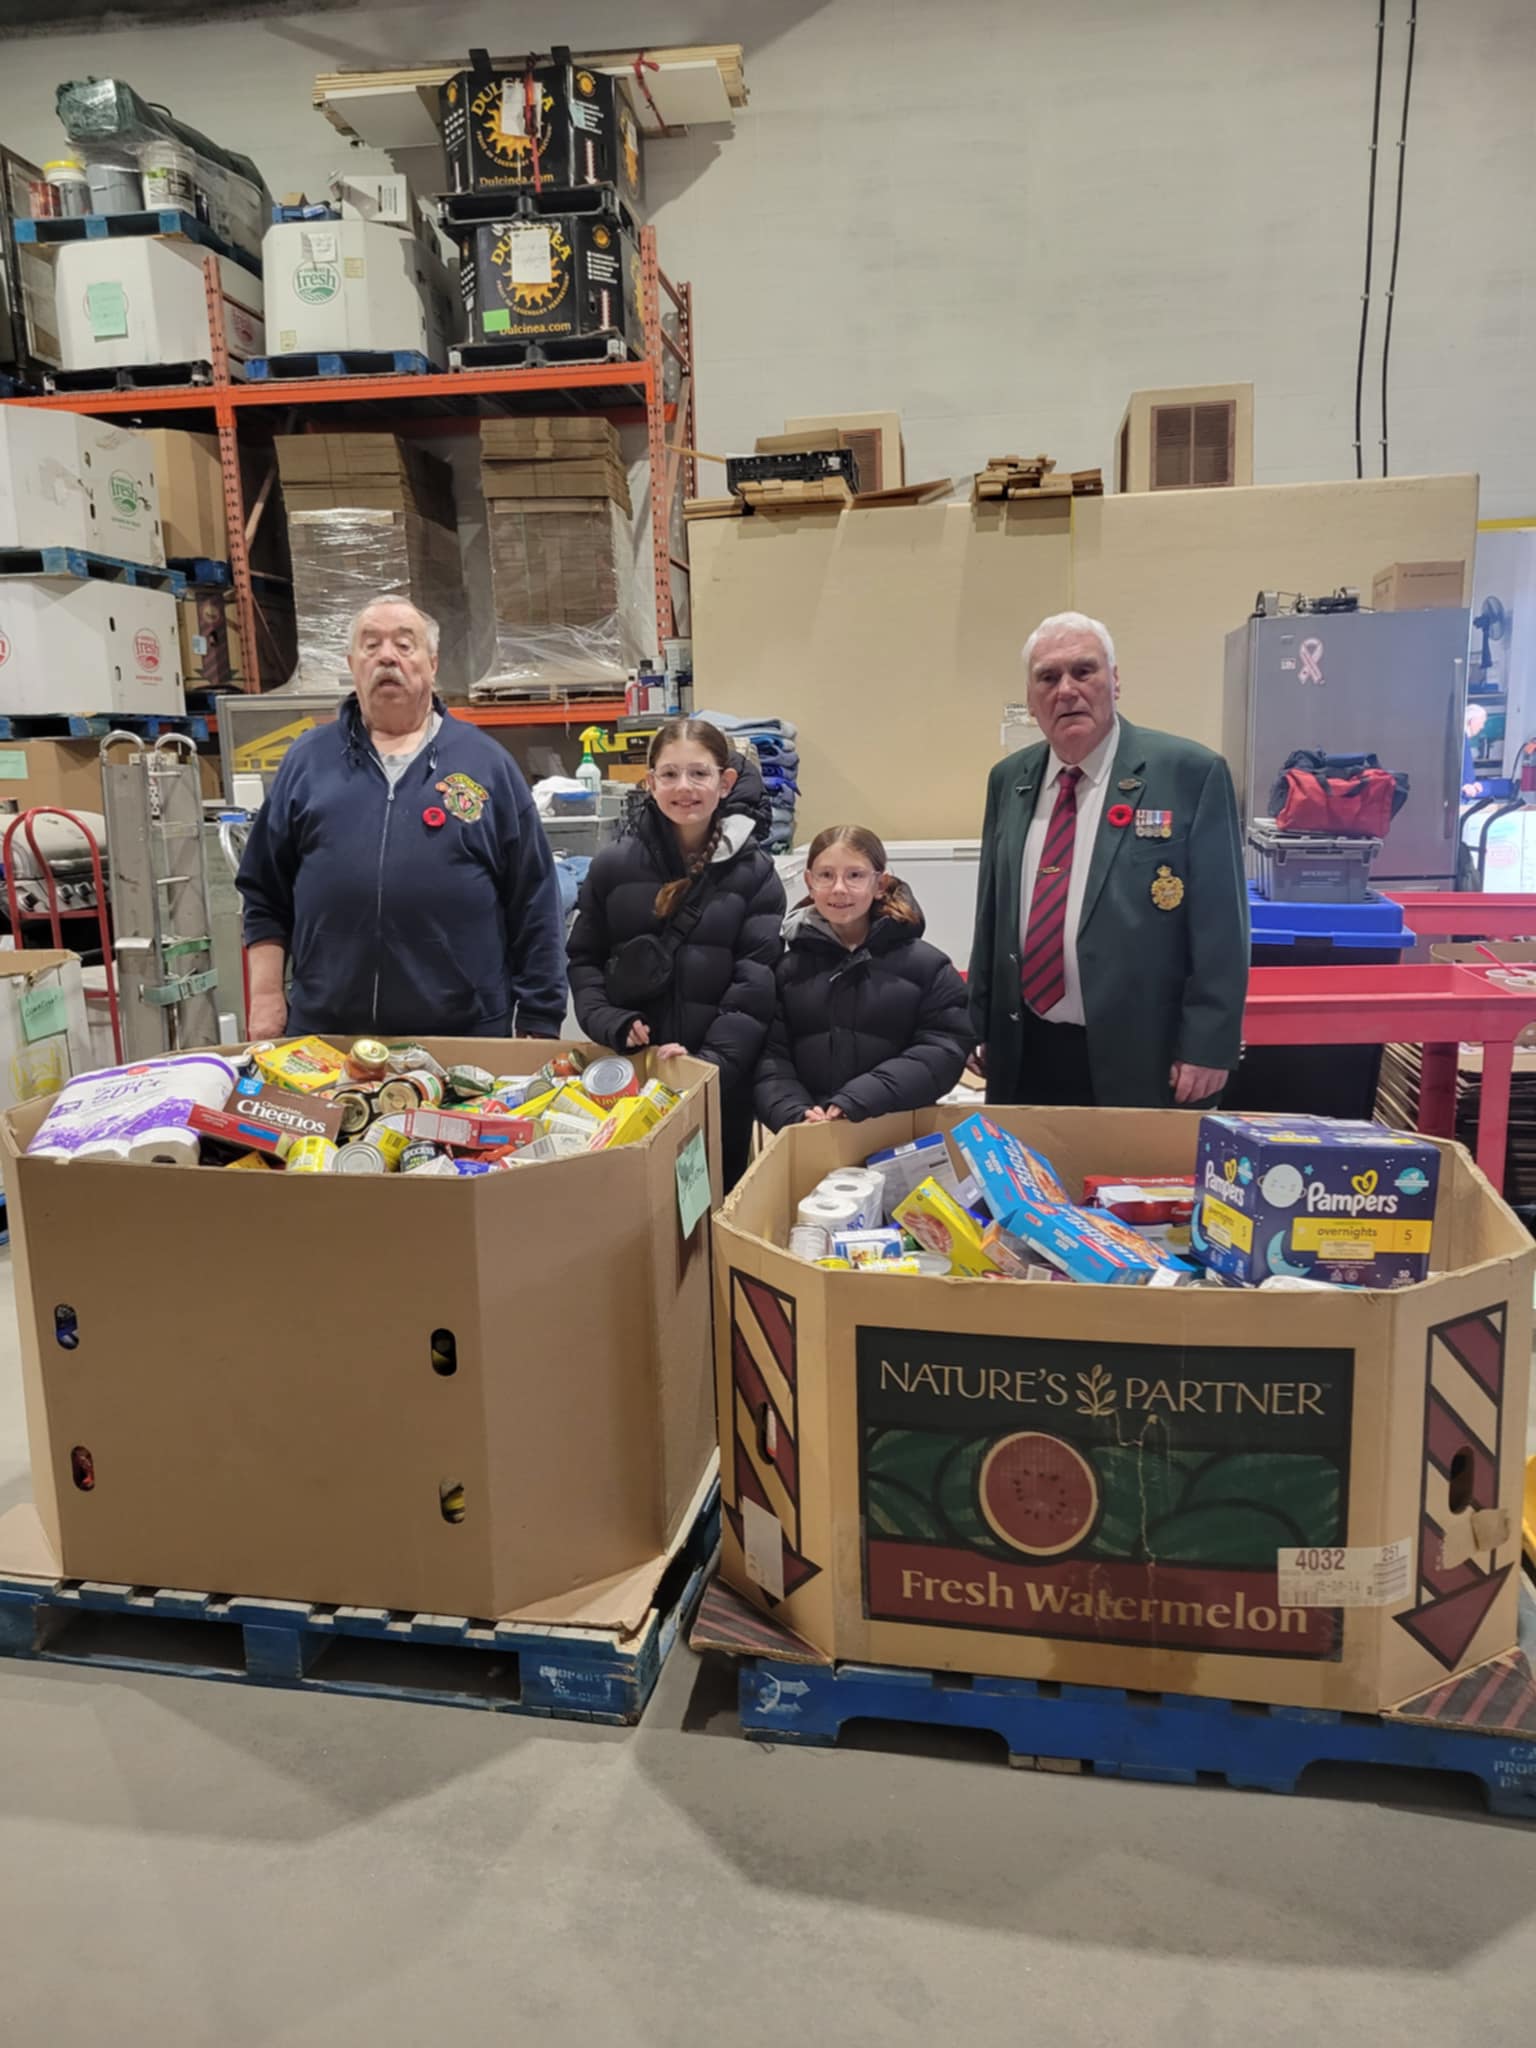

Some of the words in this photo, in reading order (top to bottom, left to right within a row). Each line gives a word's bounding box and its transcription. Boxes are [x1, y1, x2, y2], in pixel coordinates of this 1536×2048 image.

[236, 1098, 327, 1134] Cheerios
[1204, 1159, 1246, 1207] Pampers
[1306, 1181, 1399, 1217] Pampers
[1317, 1225, 1378, 1240] overnights
[1404, 1229, 1413, 1241] 5
[880, 1359, 1069, 1406] NATURE'S
[1125, 1377, 1325, 1415] PARTNER
[1295, 1549, 1345, 1570] 4032
[901, 1569, 1015, 1609] Fresh
[1025, 1581, 1308, 1634] Watermelon
